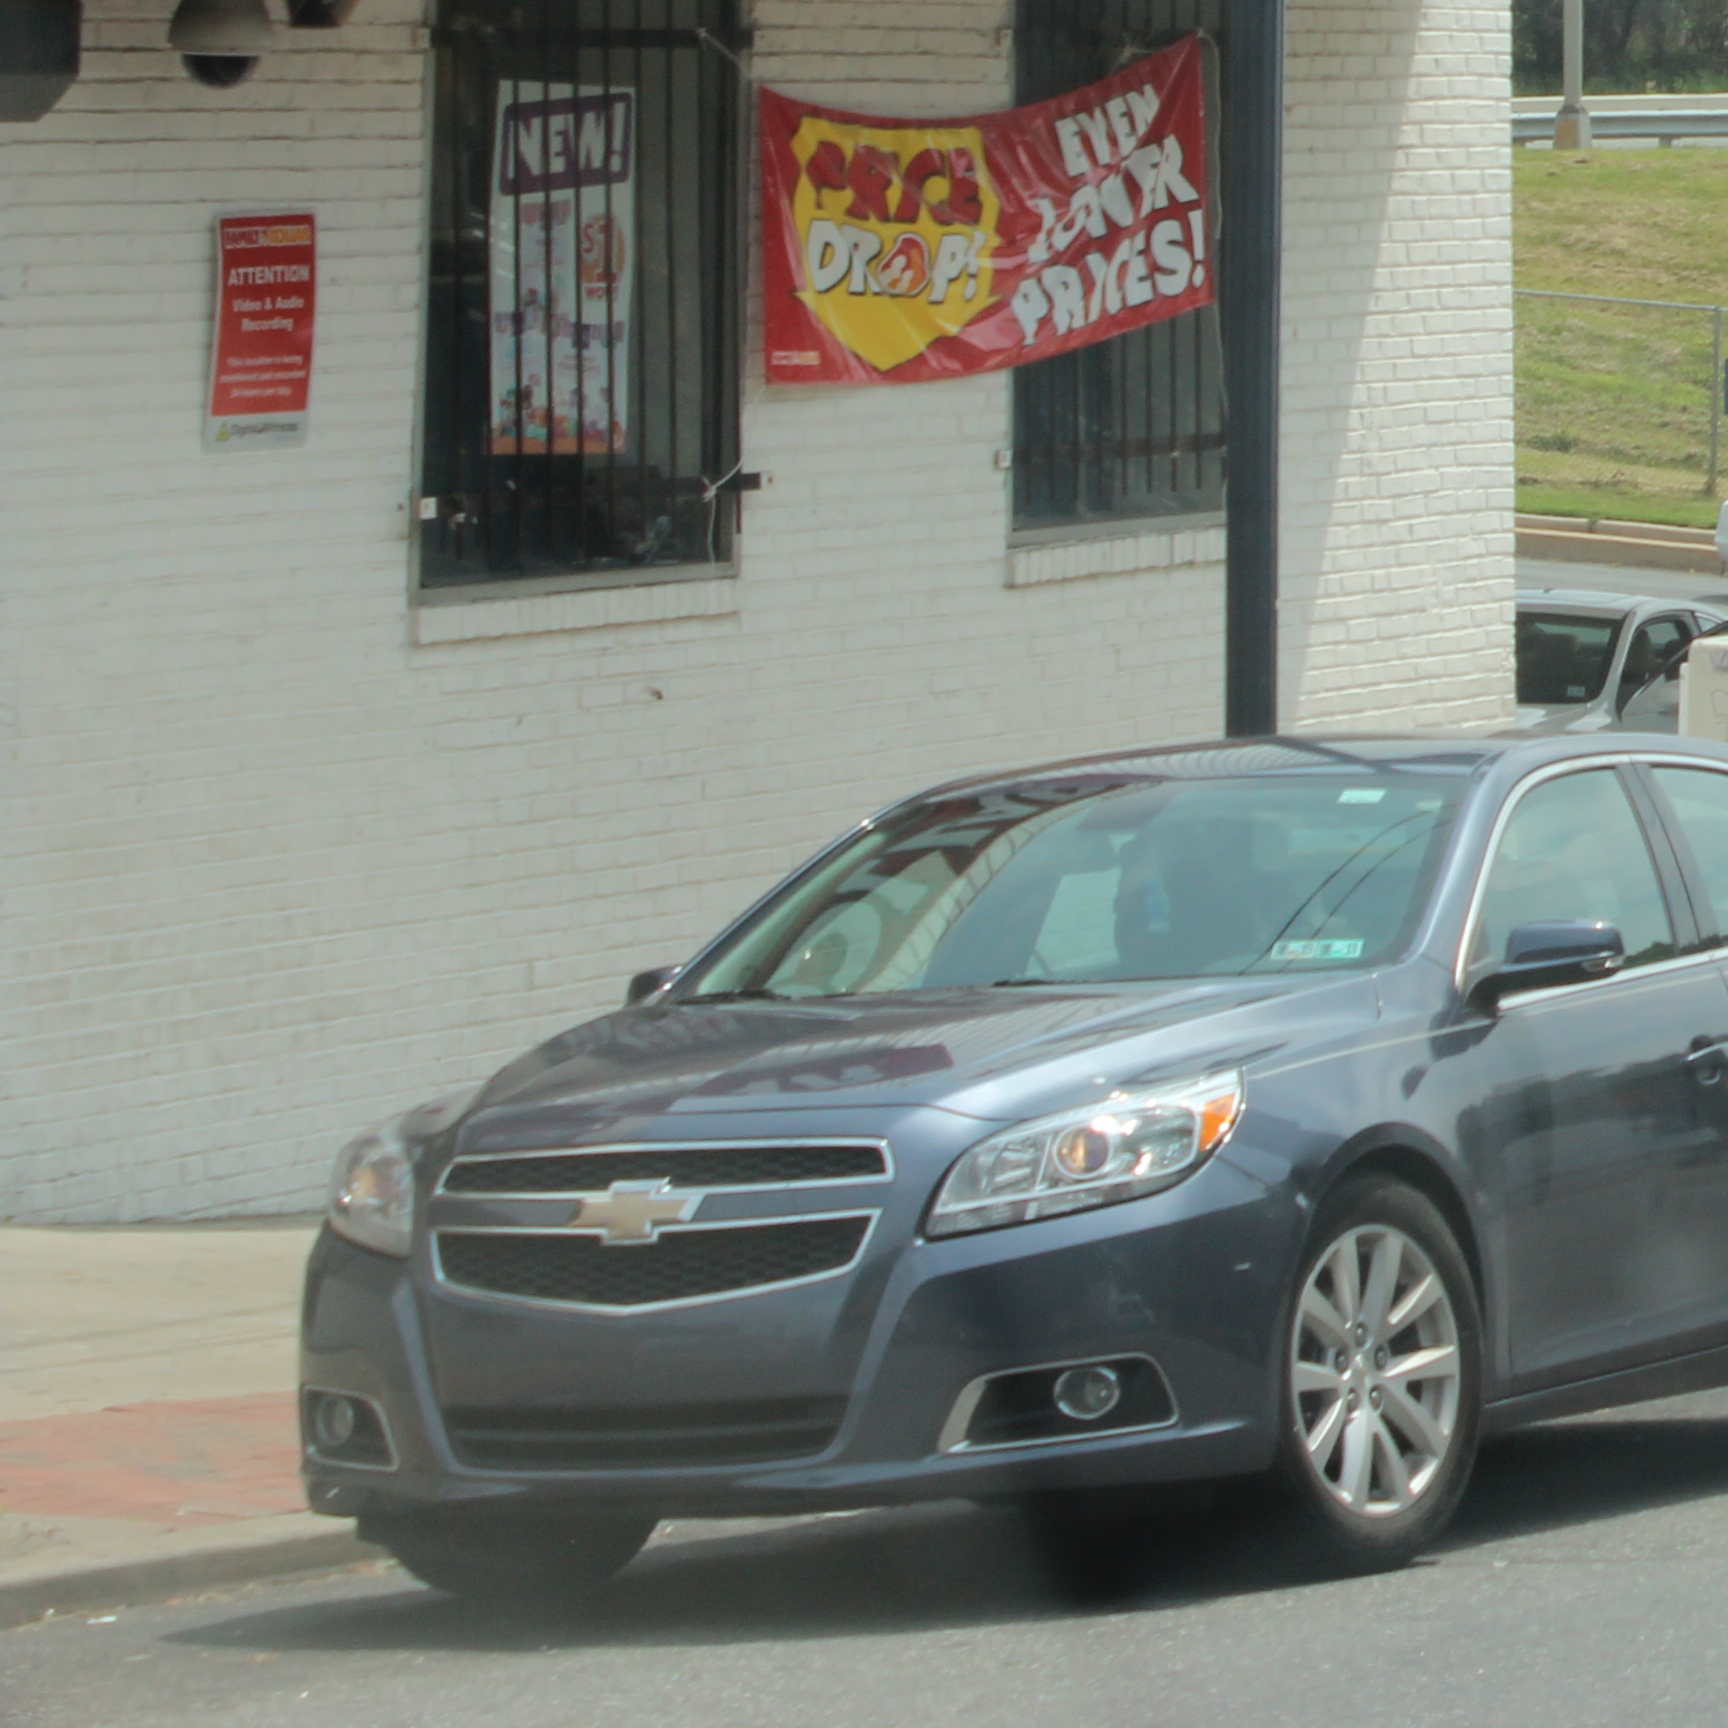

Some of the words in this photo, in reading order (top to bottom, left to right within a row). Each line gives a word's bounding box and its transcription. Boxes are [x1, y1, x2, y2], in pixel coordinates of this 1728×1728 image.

[505, 100, 628, 181] NEW!
[1054, 83, 1161, 178] EVEN
[805, 140, 984, 226] PRICE
[228, 265, 311, 286] ATTENTION
[807, 220, 987, 304] DROP!
[1010, 210, 1206, 347] PRICES!
